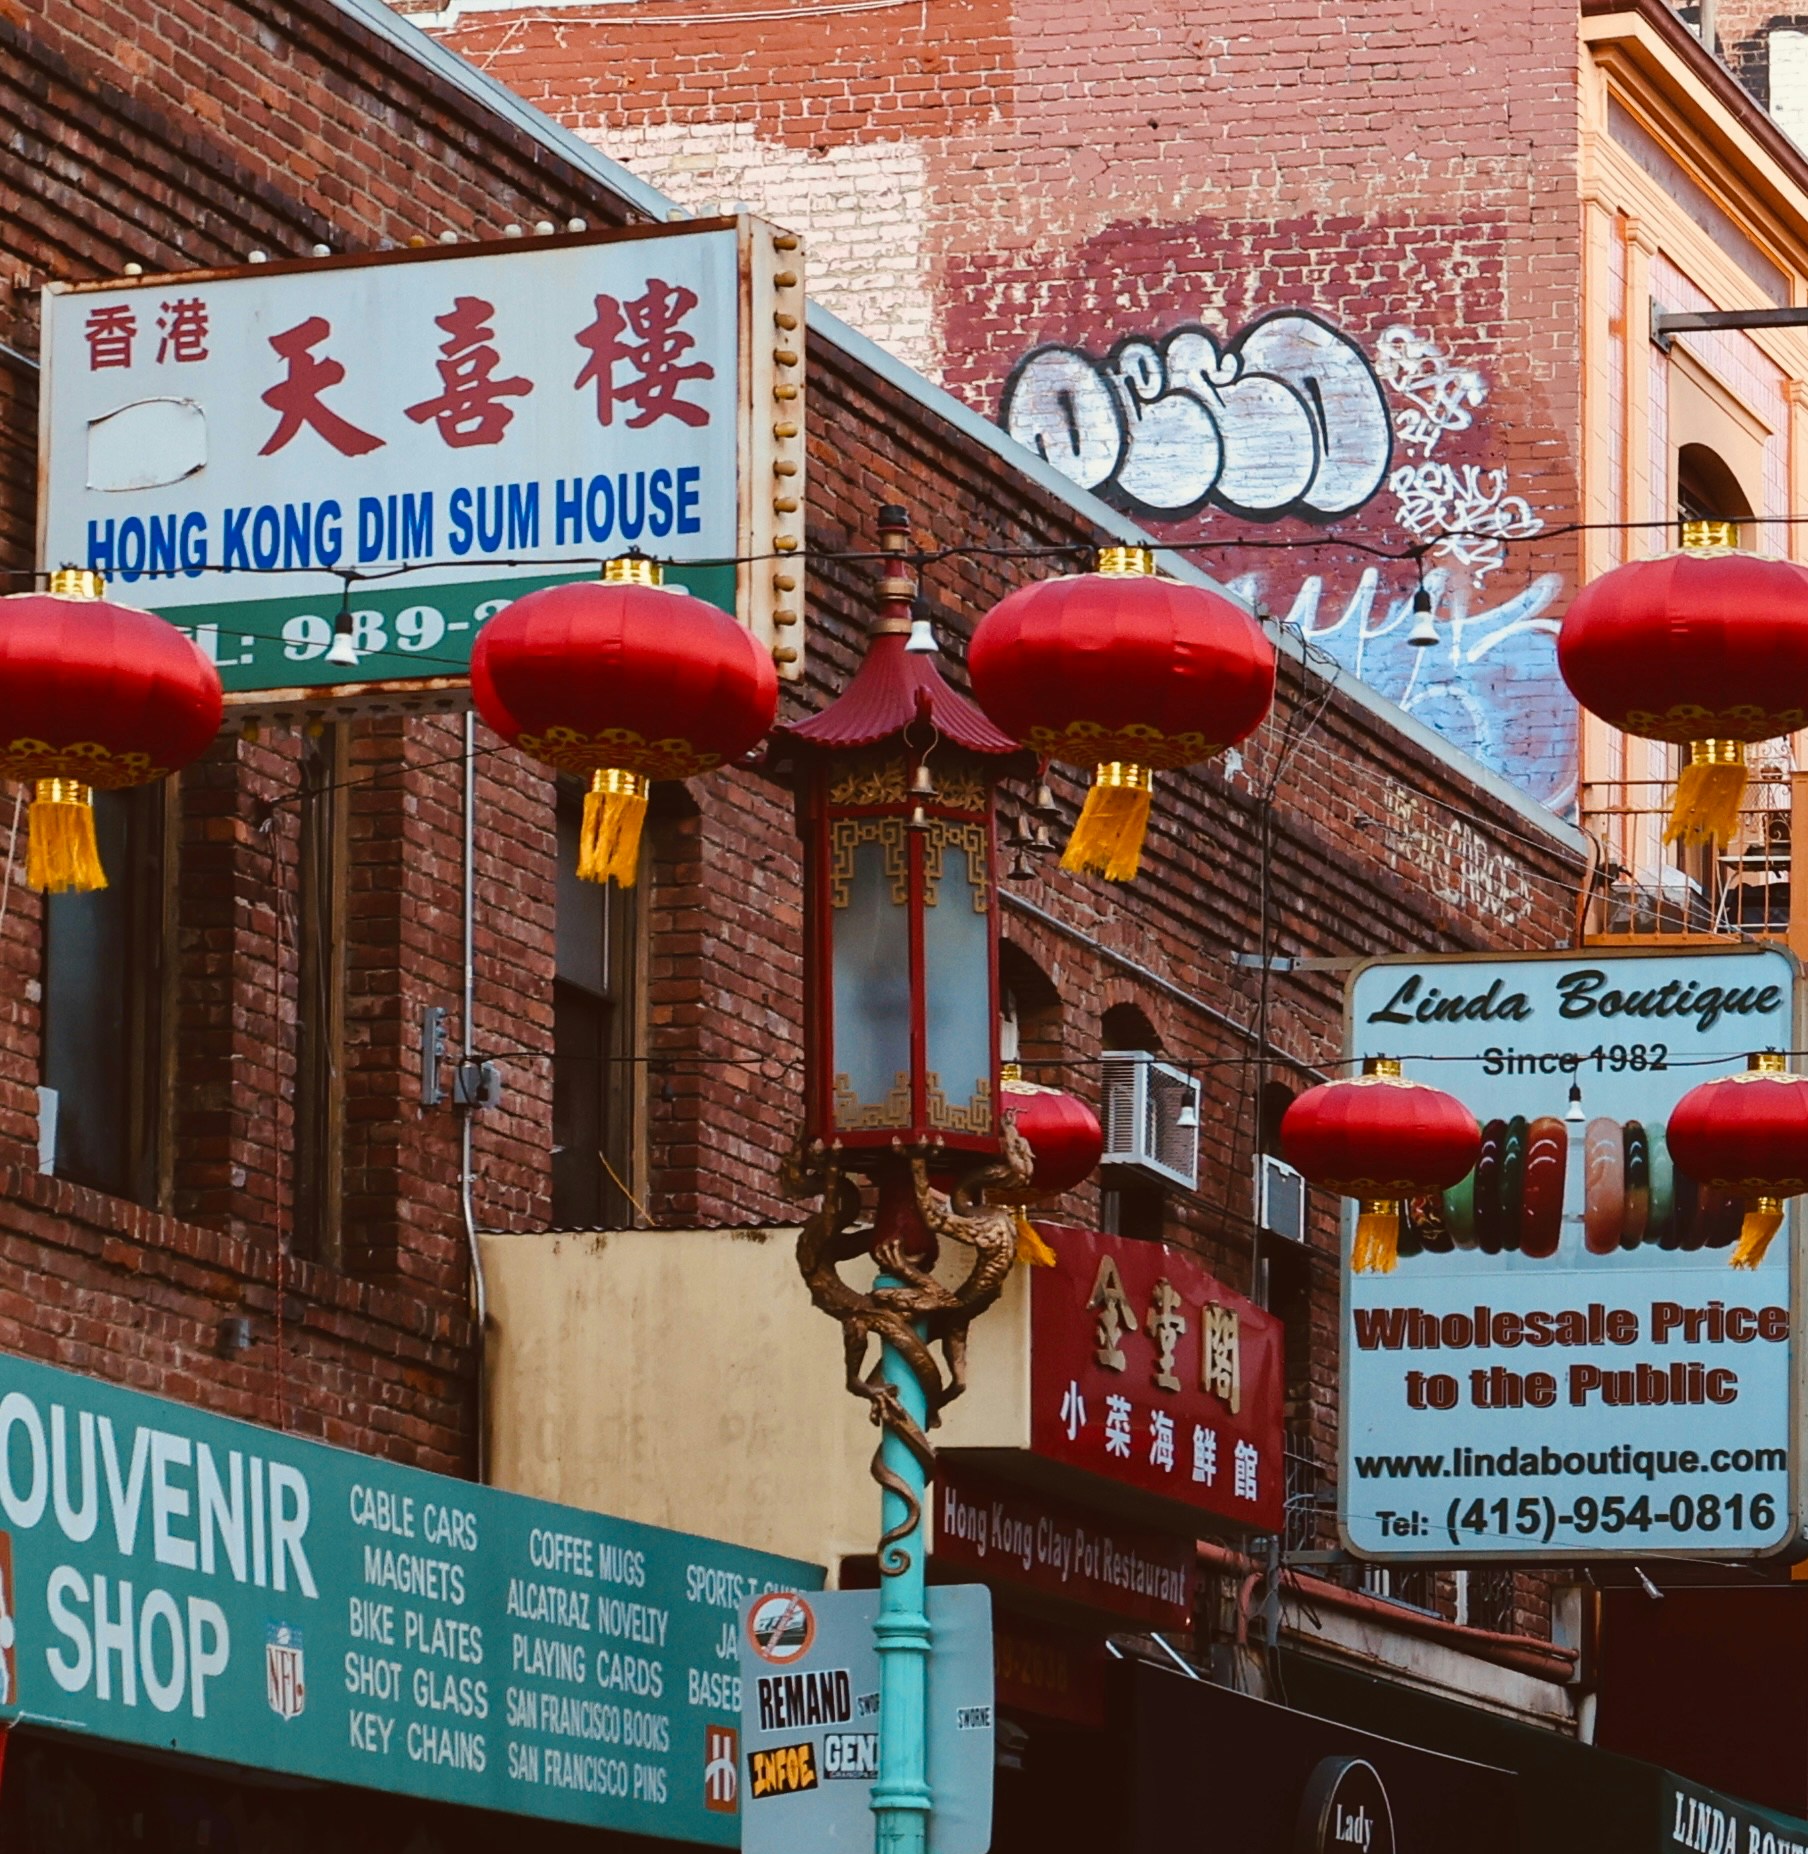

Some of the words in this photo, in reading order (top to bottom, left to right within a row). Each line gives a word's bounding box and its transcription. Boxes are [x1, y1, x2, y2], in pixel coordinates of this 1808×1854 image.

[84, 298, 210, 372] 香港
[258, 278, 717, 457] 天喜樓
[86, 517, 208, 583] HONG
[223, 500, 342, 573] KONG
[358, 491, 434, 561] DIM
[449, 482, 541, 555] SUM
[555, 466, 702, 542] HOUSE
[1368, 974, 1533, 1024] Linda
[1556, 969, 1783, 1032] Boutique
[1481, 1044, 1579, 1077] Since
[1594, 1042, 1669, 1074] 1982
[1354, 1303, 1639, 1351] Wholesale
[1651, 1300, 1790, 1346] Price
[1405, 1369, 1460, 1411] to
[1470, 1366, 1556, 1409] the
[1569, 1363, 1739, 1408] Public
[1059, 1379, 1259, 1502] 小菜海鮮館
[1355, 1444, 1788, 1483] www.lindaboutique.com
[0, 1391, 320, 1600] OUVENIR
[349, 1483, 415, 1540] CABLE
[423, 1502, 479, 1552] CARS
[1376, 1509, 1430, 1540] Tel:
[1446, 1491, 1777, 1545] (415)-954-0816
[364, 1545, 465, 1606] MAGNETS
[529, 1527, 595, 1579] COFFEE
[599, 1544, 646, 1589] MUGS
[943, 1490, 989, 1558] Hong
[992, 1501, 1035, 1572] Kong
[1036, 1515, 1071, 1584] Clay
[1073, 1528, 1101, 1581] Pot
[1102, 1539, 1187, 1607] Restaurant
[506, 1578, 591, 1631] ALCATRAZ
[598, 1596, 670, 1649] NOVELTY
[686, 1563, 745, 1611] SPORTS
[46, 1564, 231, 1719] SHOP
[348, 1597, 394, 1646] BIKE
[405, 1610, 484, 1664] PLATES
[715, 1624, 742, 1662] JA
[267, 1643, 304, 1716] NFL
[344, 1651, 403, 1702] SHOT
[412, 1667, 489, 1721] GLASS
[512, 1634, 587, 1684] PLAYING
[596, 1649, 664, 1699] CARDS
[687, 1669, 742, 1714] BASEB
[506, 1686, 539, 1728] SAN
[541, 1694, 622, 1745] FRANCISCO
[624, 1711, 671, 1753] BOOKS
[758, 1671, 853, 1731] REMAND
[349, 1709, 396, 1754] KEY
[406, 1722, 488, 1773] CHAINS
[508, 1741, 541, 1781] SAN
[544, 1747, 628, 1797] FRANCISCO
[633, 1764, 668, 1805] PINS
[824, 1735, 880, 1769] GEN
[1335, 1803, 1375, 1854] Lady
